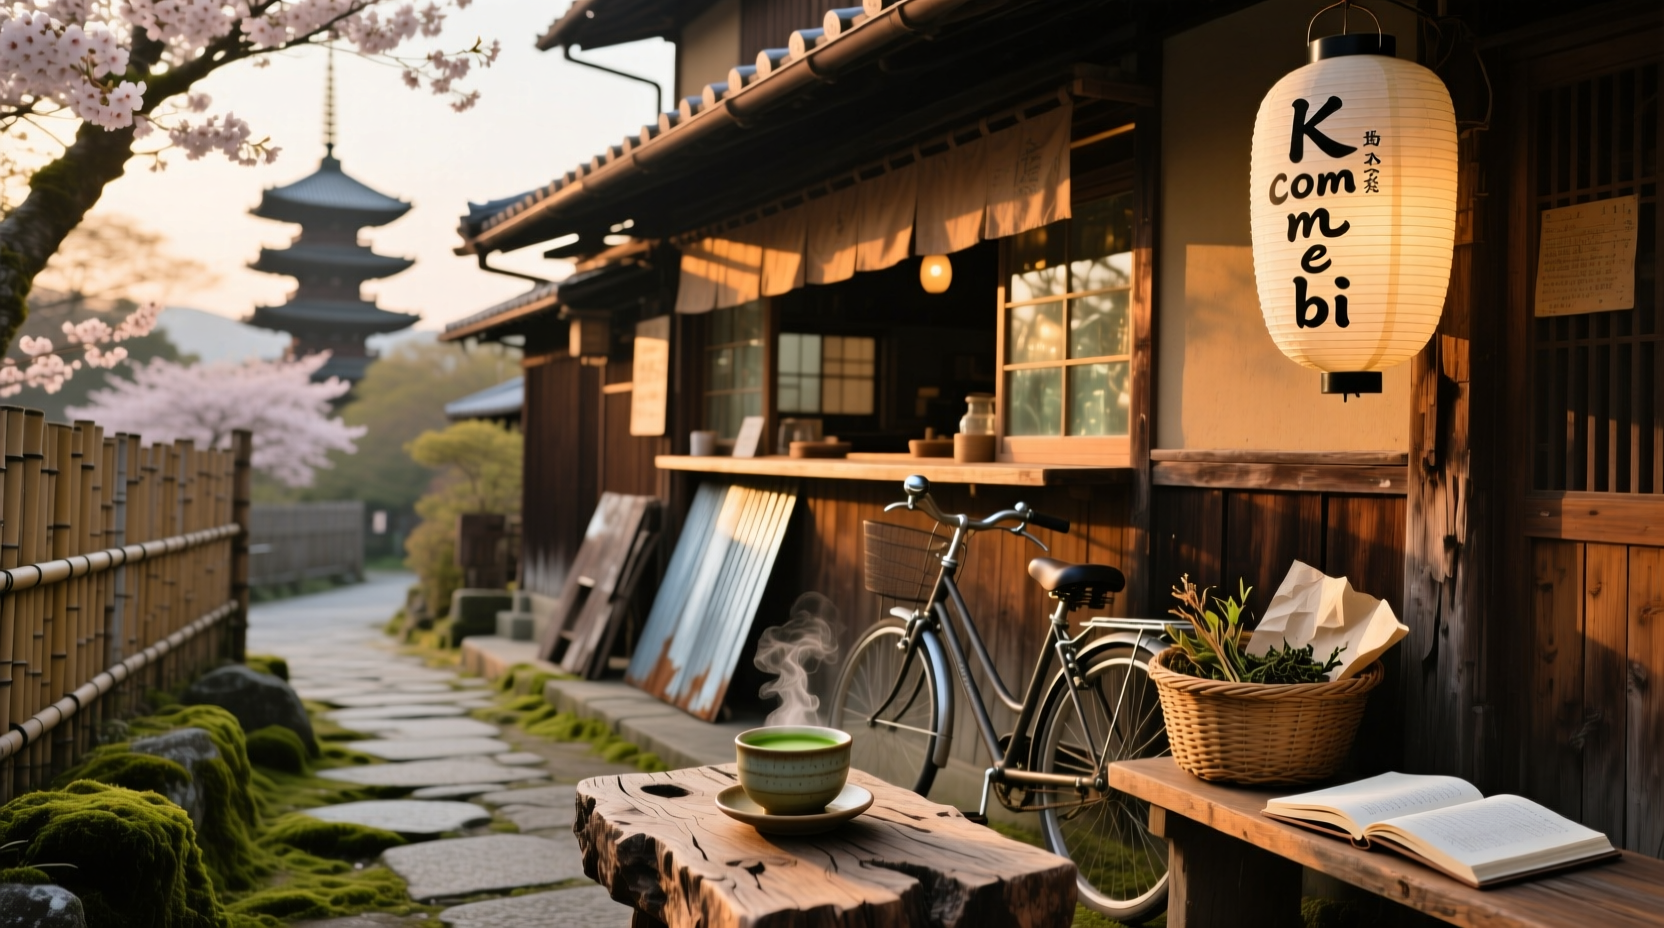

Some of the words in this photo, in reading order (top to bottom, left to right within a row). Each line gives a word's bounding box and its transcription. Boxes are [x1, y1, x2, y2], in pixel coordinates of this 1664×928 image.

[1289, 95, 1358, 164] K
[1269, 169, 1356, 205] com
[1293, 276, 1350, 329] bi
